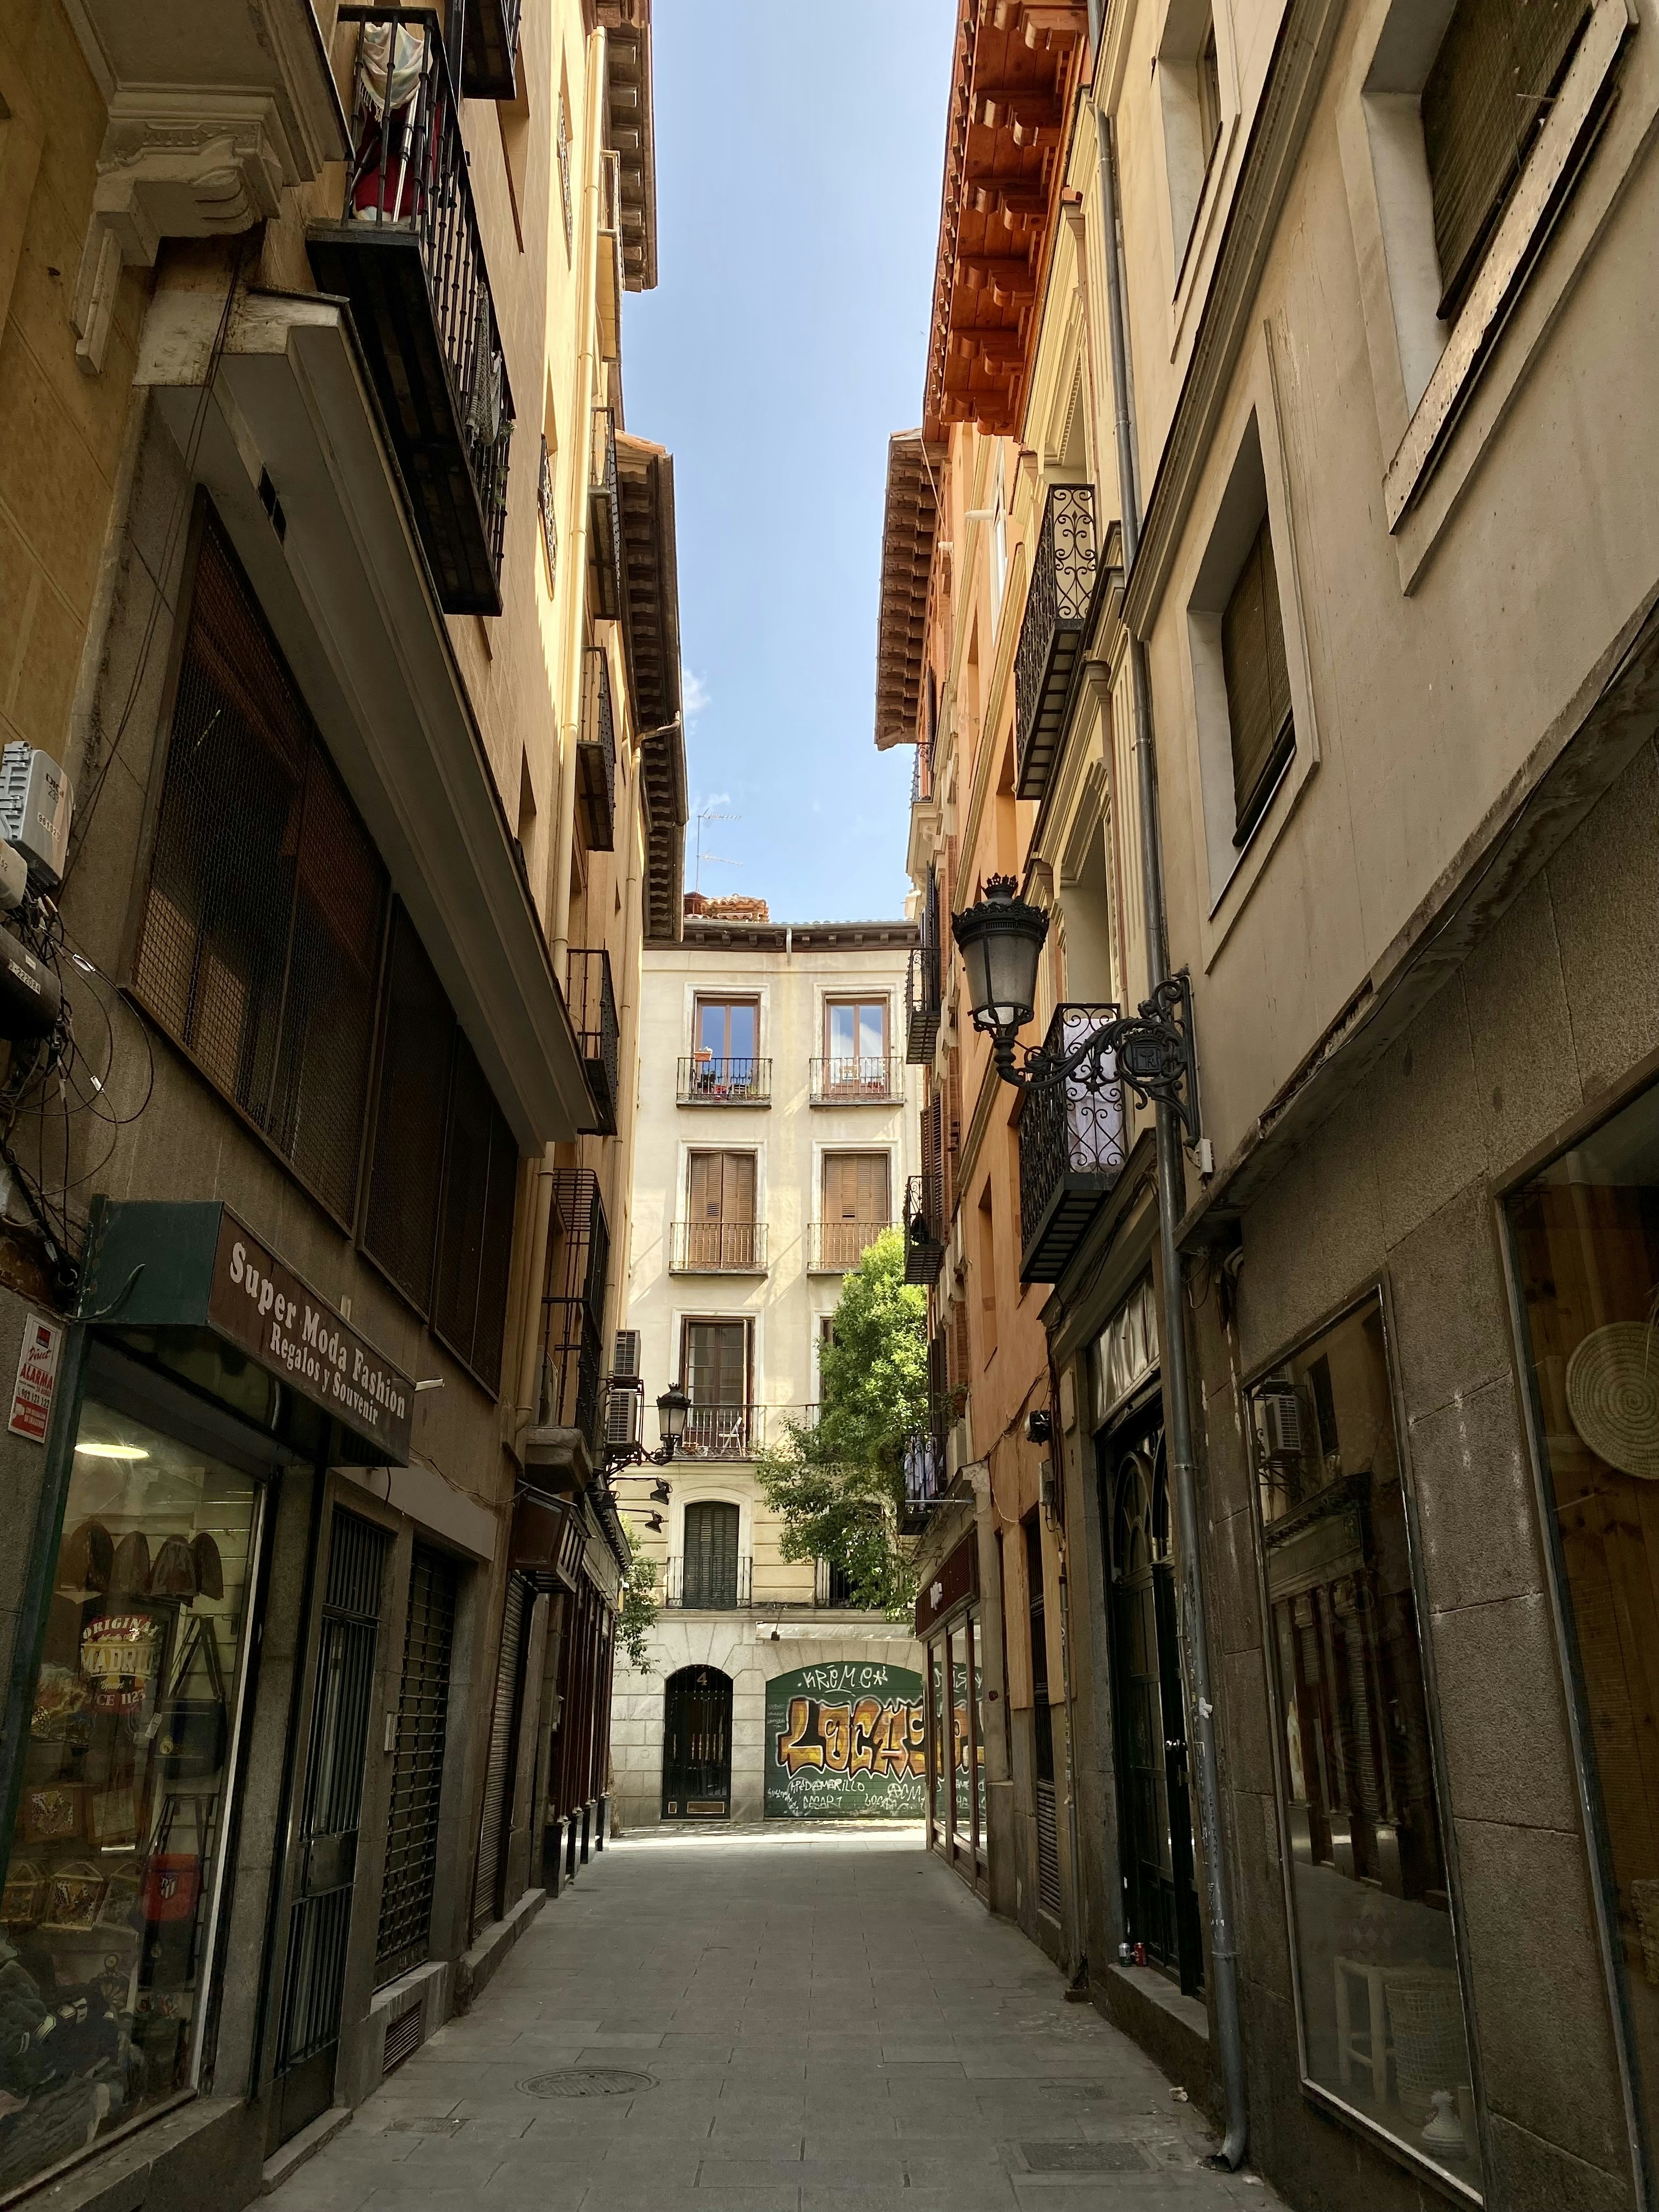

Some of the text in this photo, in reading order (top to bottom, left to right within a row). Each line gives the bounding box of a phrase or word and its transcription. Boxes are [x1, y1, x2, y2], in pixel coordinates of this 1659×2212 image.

[46, 772, 64, 798] DIGI
[230, 1242, 405, 1419] Super Moda Fashion
[20, 1363, 53, 1390] ALARMA
[270, 1322, 378, 1425] Regalos y Souvenir
[697, 1672, 707, 1685] 4
[122, 1688, 146, 1705] 1123
